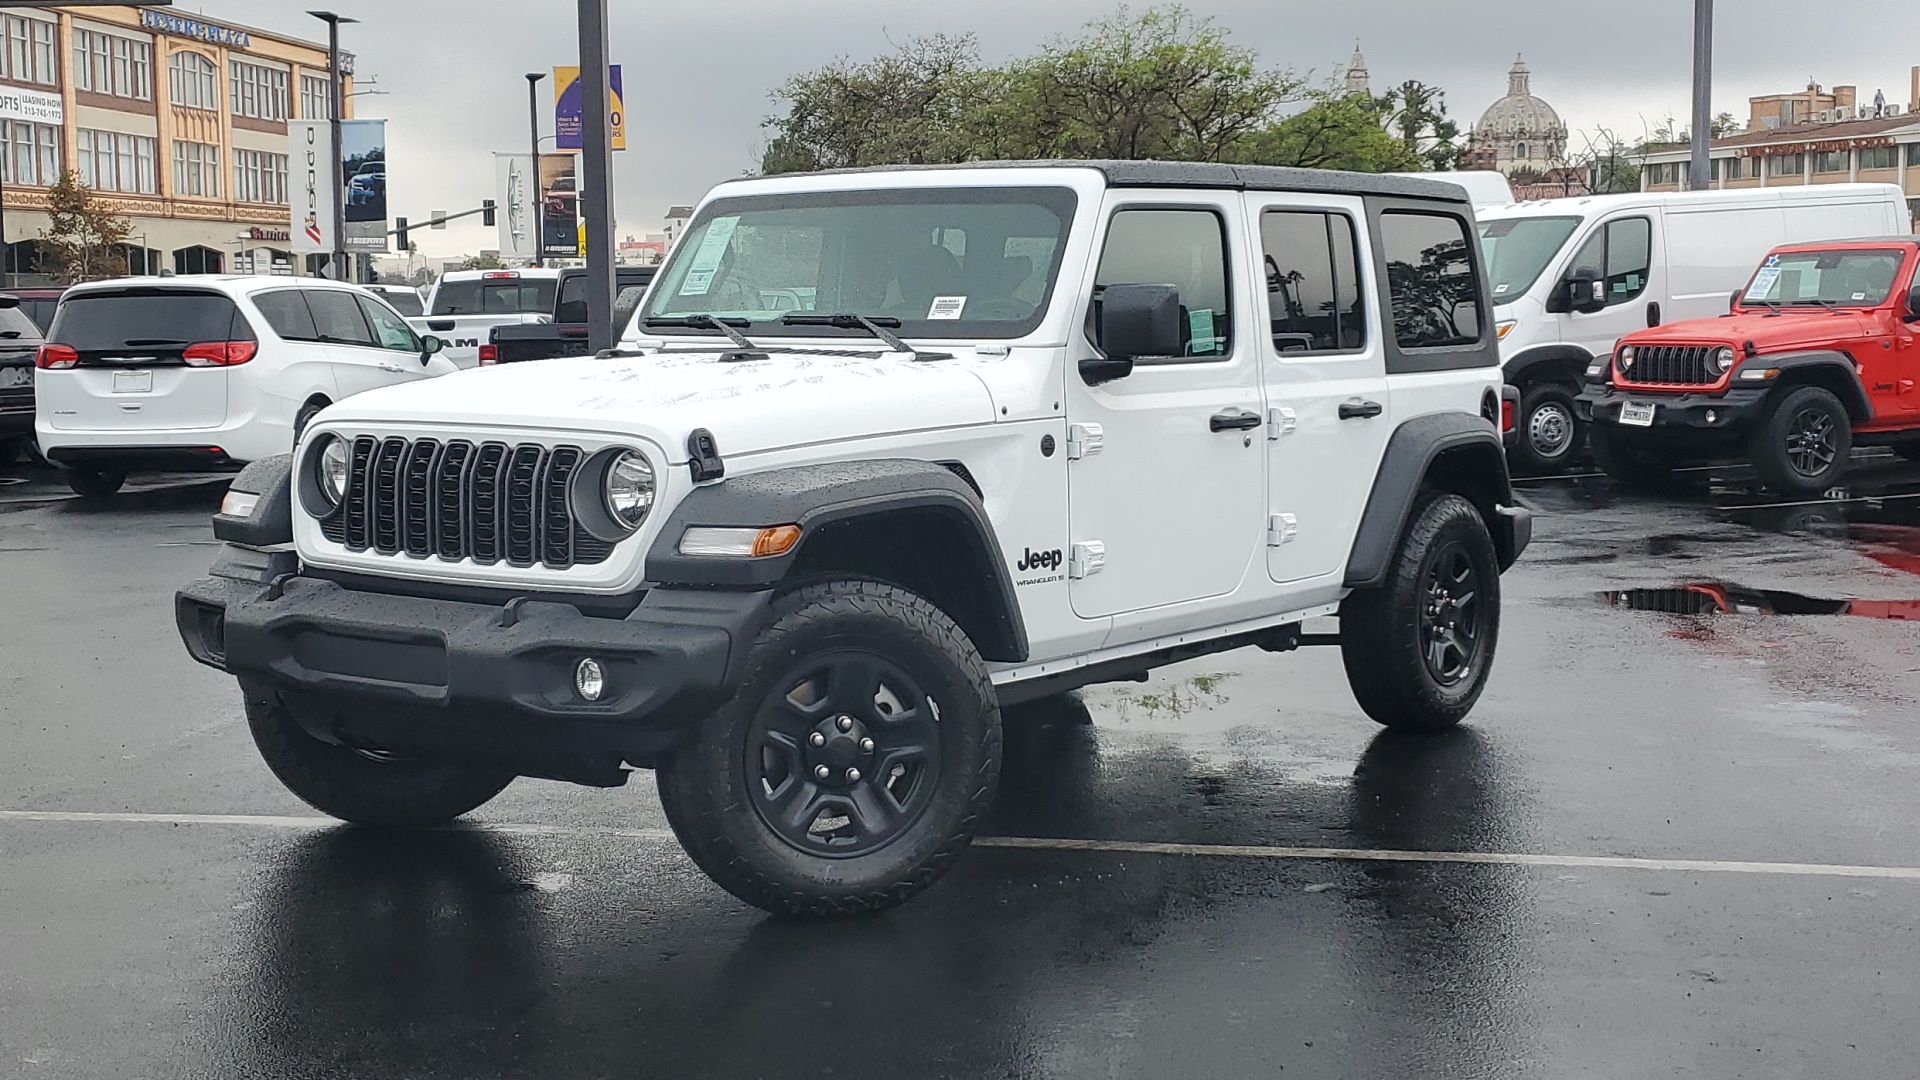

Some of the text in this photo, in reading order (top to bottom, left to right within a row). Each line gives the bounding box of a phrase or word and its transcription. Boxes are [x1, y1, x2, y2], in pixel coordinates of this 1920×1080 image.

[22, 94, 46, 107] LEASING
[441, 338, 478, 348] AM
[1017, 547, 1063, 572] Jeep
[1016, 576, 1057, 587] WRANGLER
